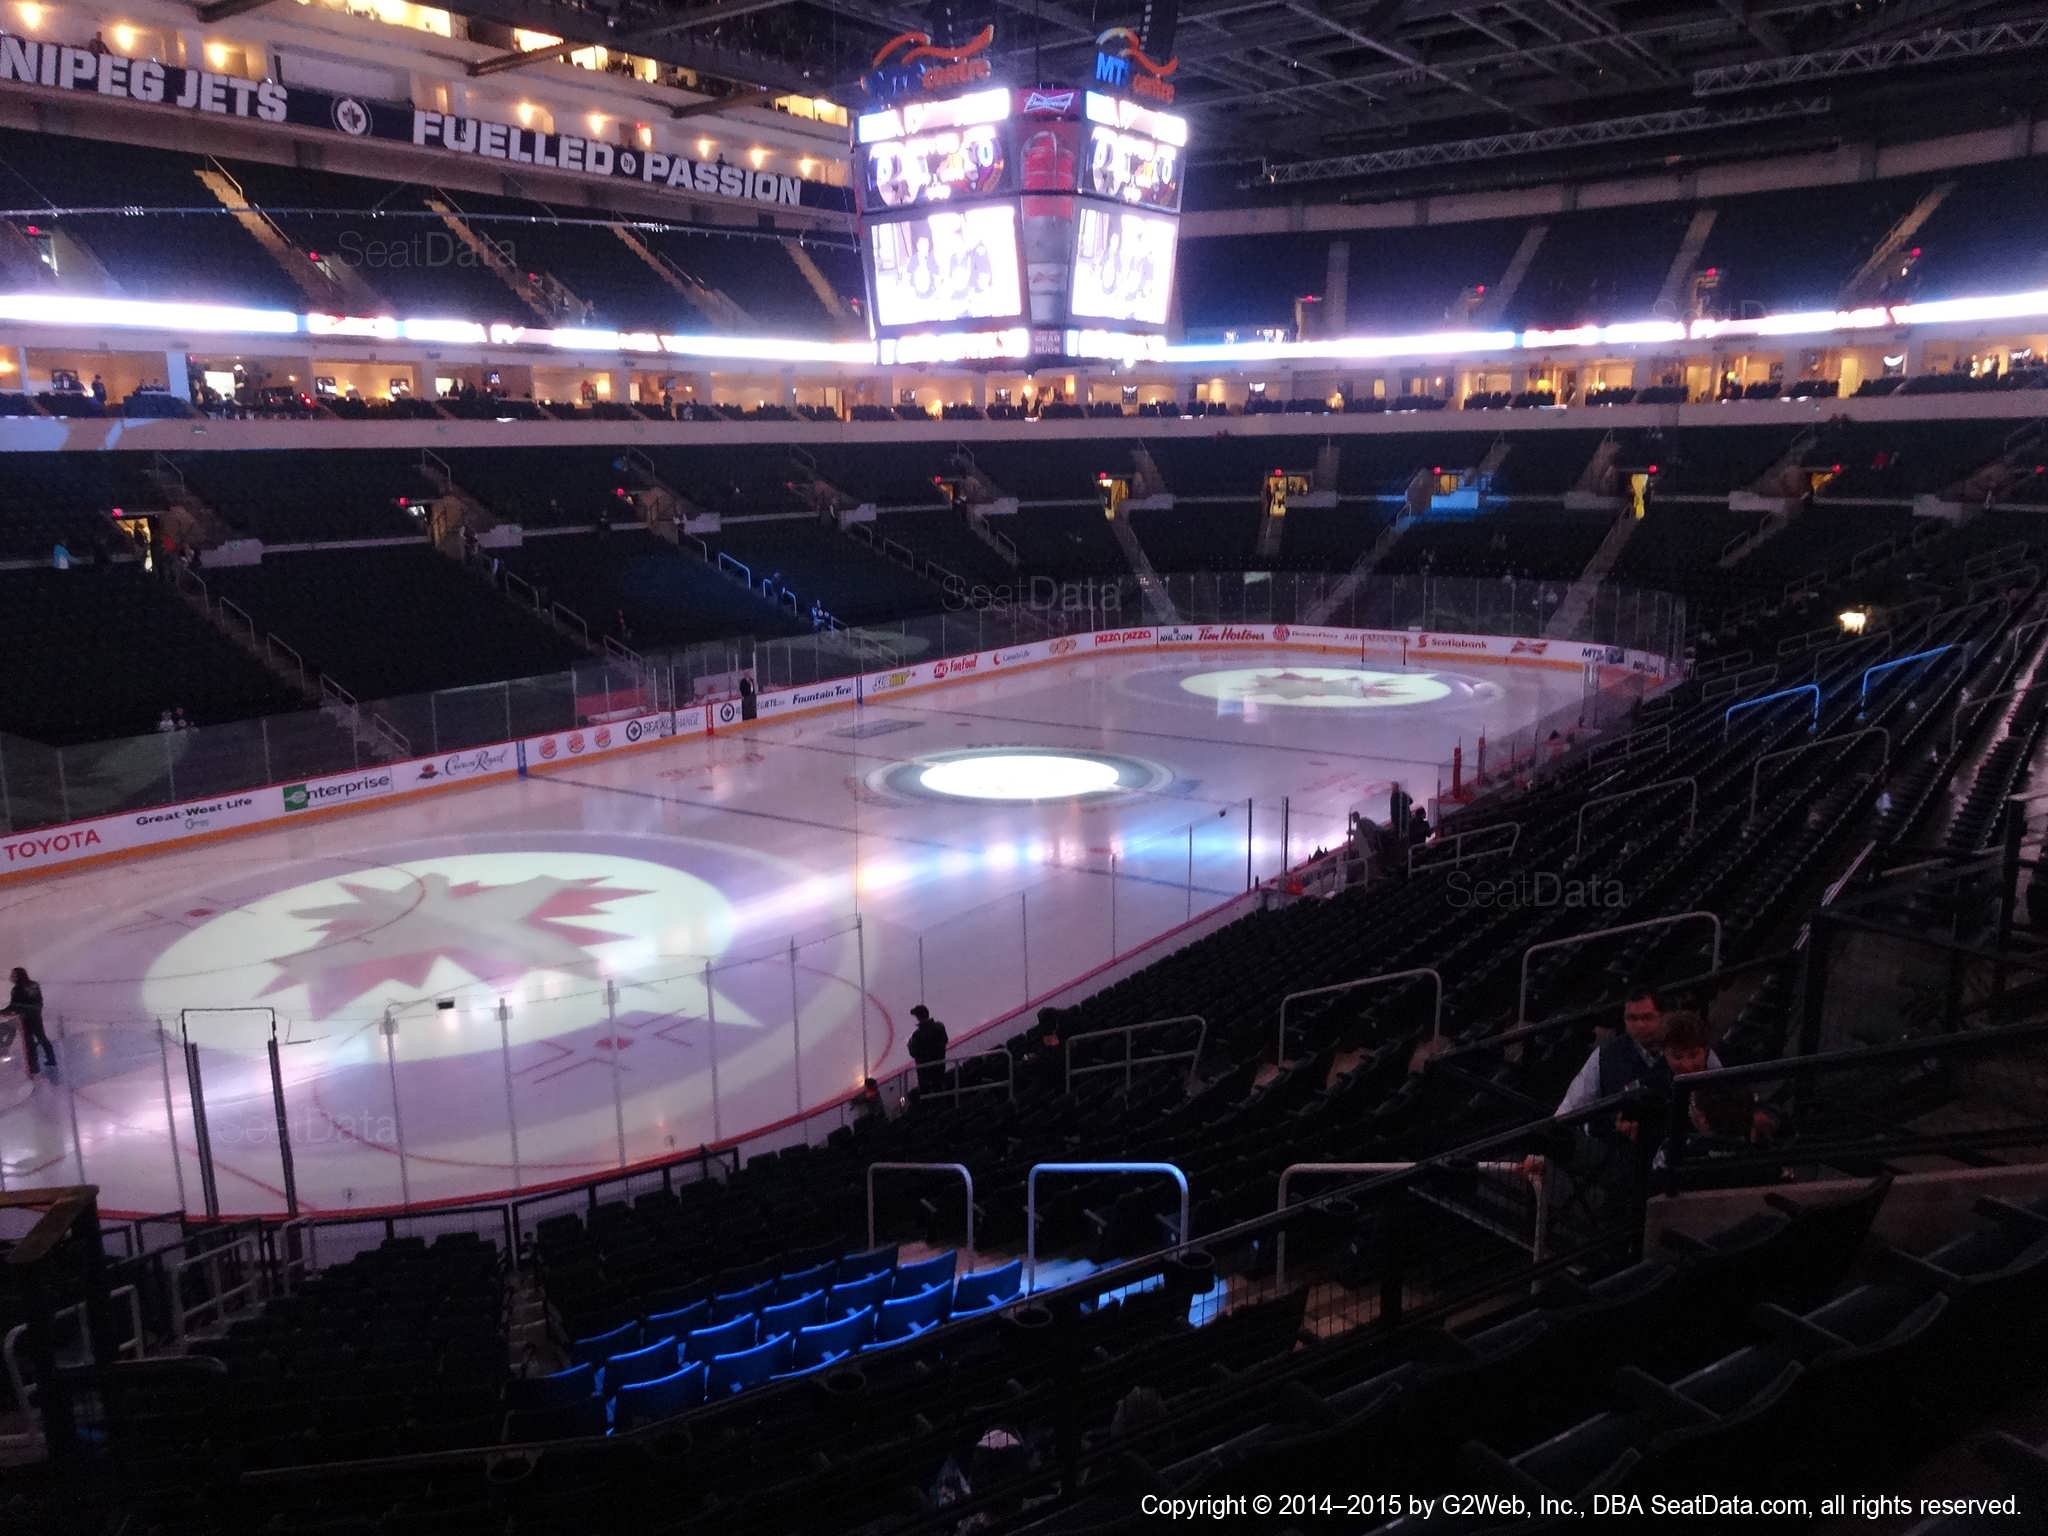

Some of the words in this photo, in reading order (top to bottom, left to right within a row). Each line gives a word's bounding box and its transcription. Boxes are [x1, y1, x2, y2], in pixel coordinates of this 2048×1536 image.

[0, 36, 166, 103] NIPEG
[176, 69, 287, 123] JETS
[412, 109, 615, 176] FUELLED
[642, 151, 802, 207] PASSION
[1095, 632, 1121, 647] pizza
[1122, 630, 1152, 644] pizza
[1198, 627, 1219, 641] Tim
[1221, 626, 1266, 641] Hortons
[792, 690, 834, 705] Fountain
[835, 685, 852, 697] Tire
[227, 797, 253, 809] Life
[4, 829, 101, 861] TOYOTA
